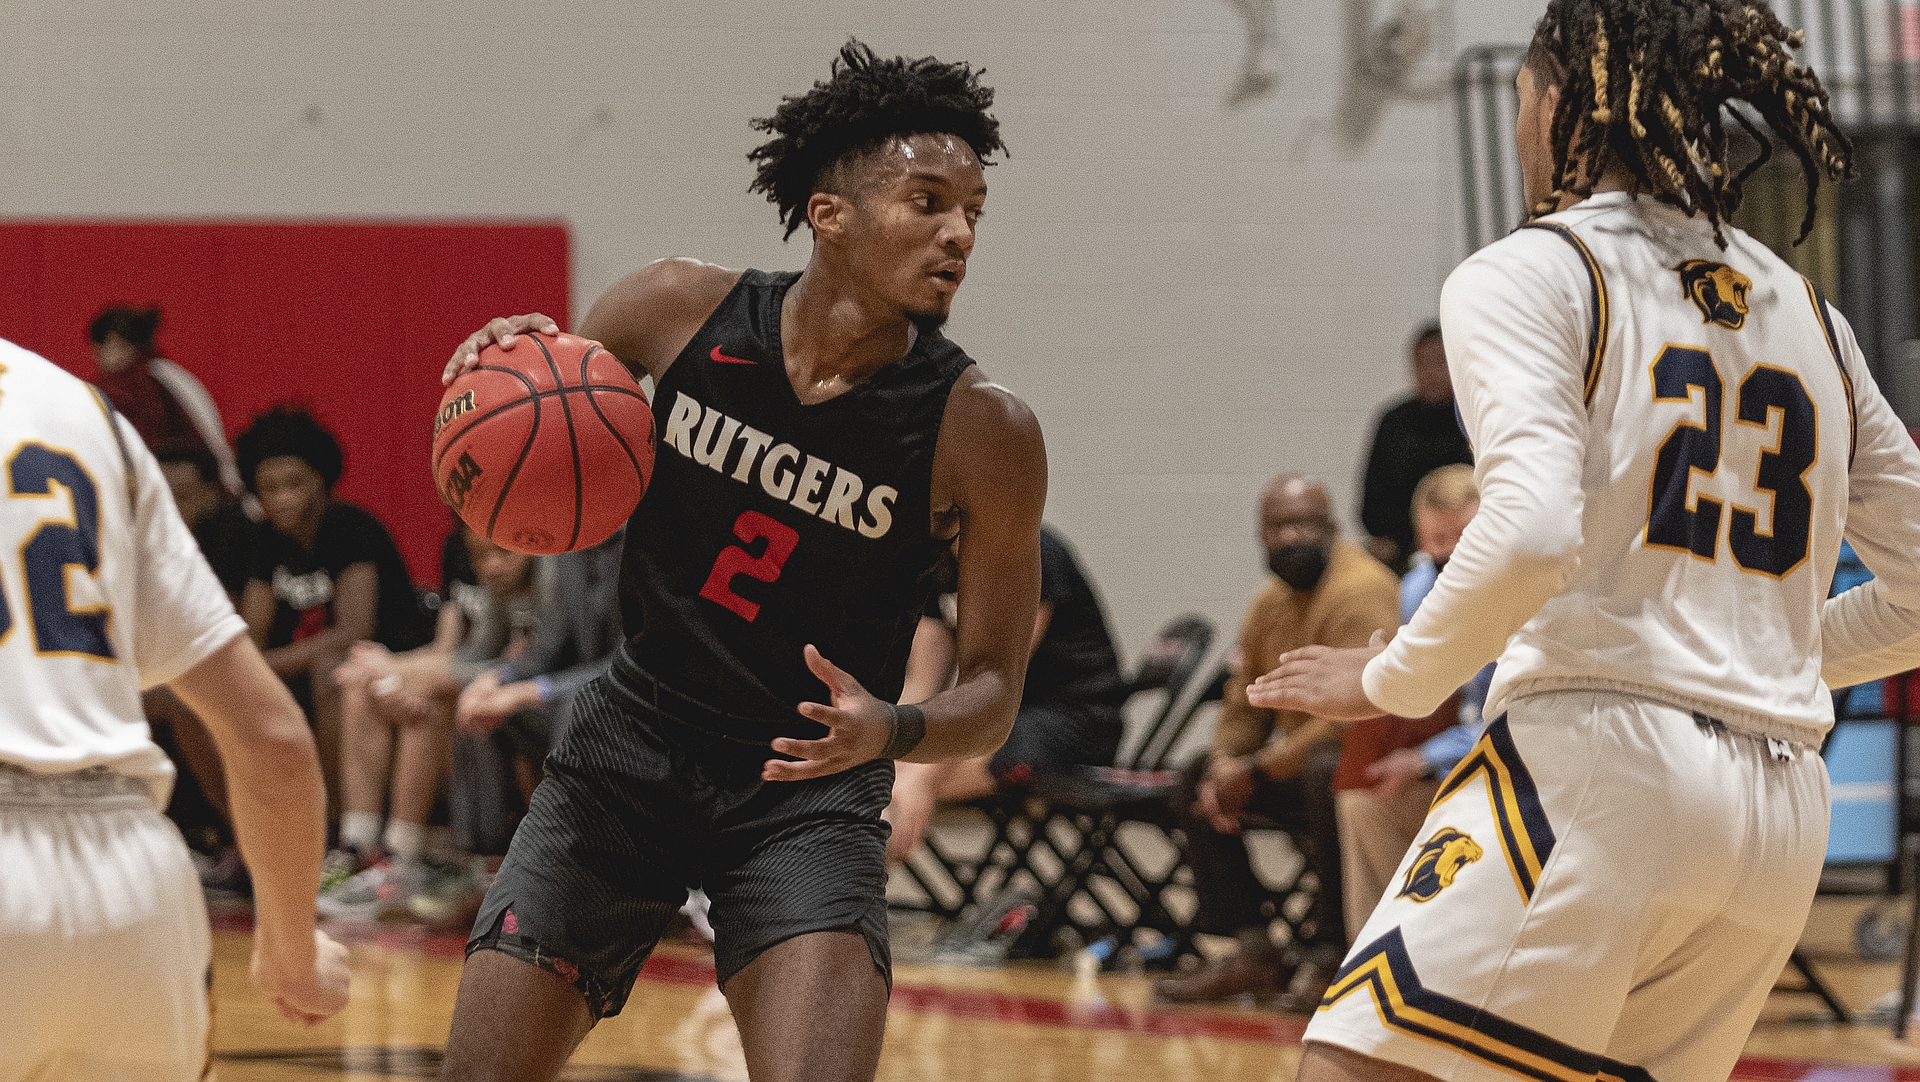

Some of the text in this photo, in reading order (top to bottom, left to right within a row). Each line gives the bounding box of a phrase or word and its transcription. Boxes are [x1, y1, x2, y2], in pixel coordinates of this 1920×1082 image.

[0, 438, 119, 663] 2
[663, 390, 898, 539] RUTGERS
[1643, 342, 1818, 580] 23
[699, 509, 800, 623] 2
